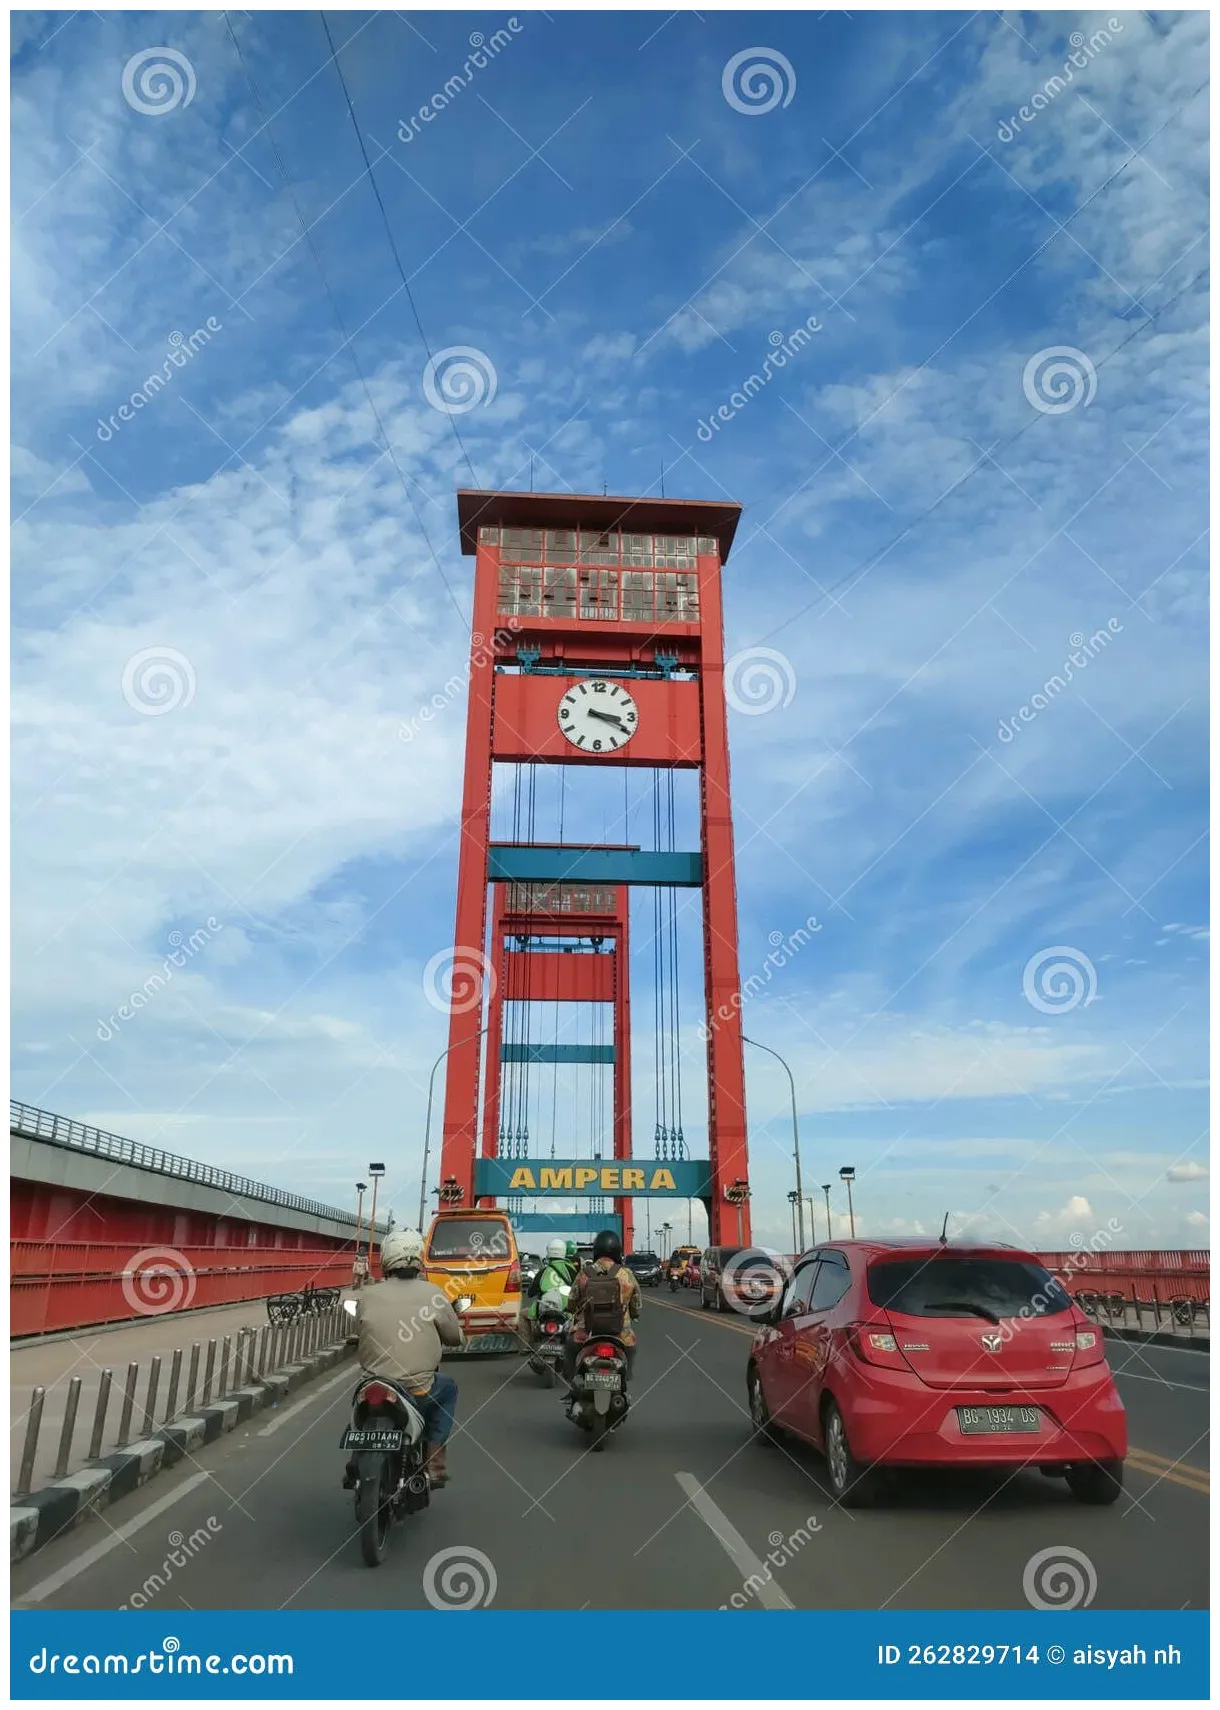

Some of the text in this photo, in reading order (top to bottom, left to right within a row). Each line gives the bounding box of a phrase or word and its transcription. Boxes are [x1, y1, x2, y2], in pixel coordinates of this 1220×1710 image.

[591, 682, 607, 693] 12
[560, 708, 570, 719] 9
[626, 712, 636, 722] 3
[592, 739, 602, 750] 6
[509, 1167, 677, 1190] AMPERA
[963, 1407, 1036, 1424] BG 1934 DS
